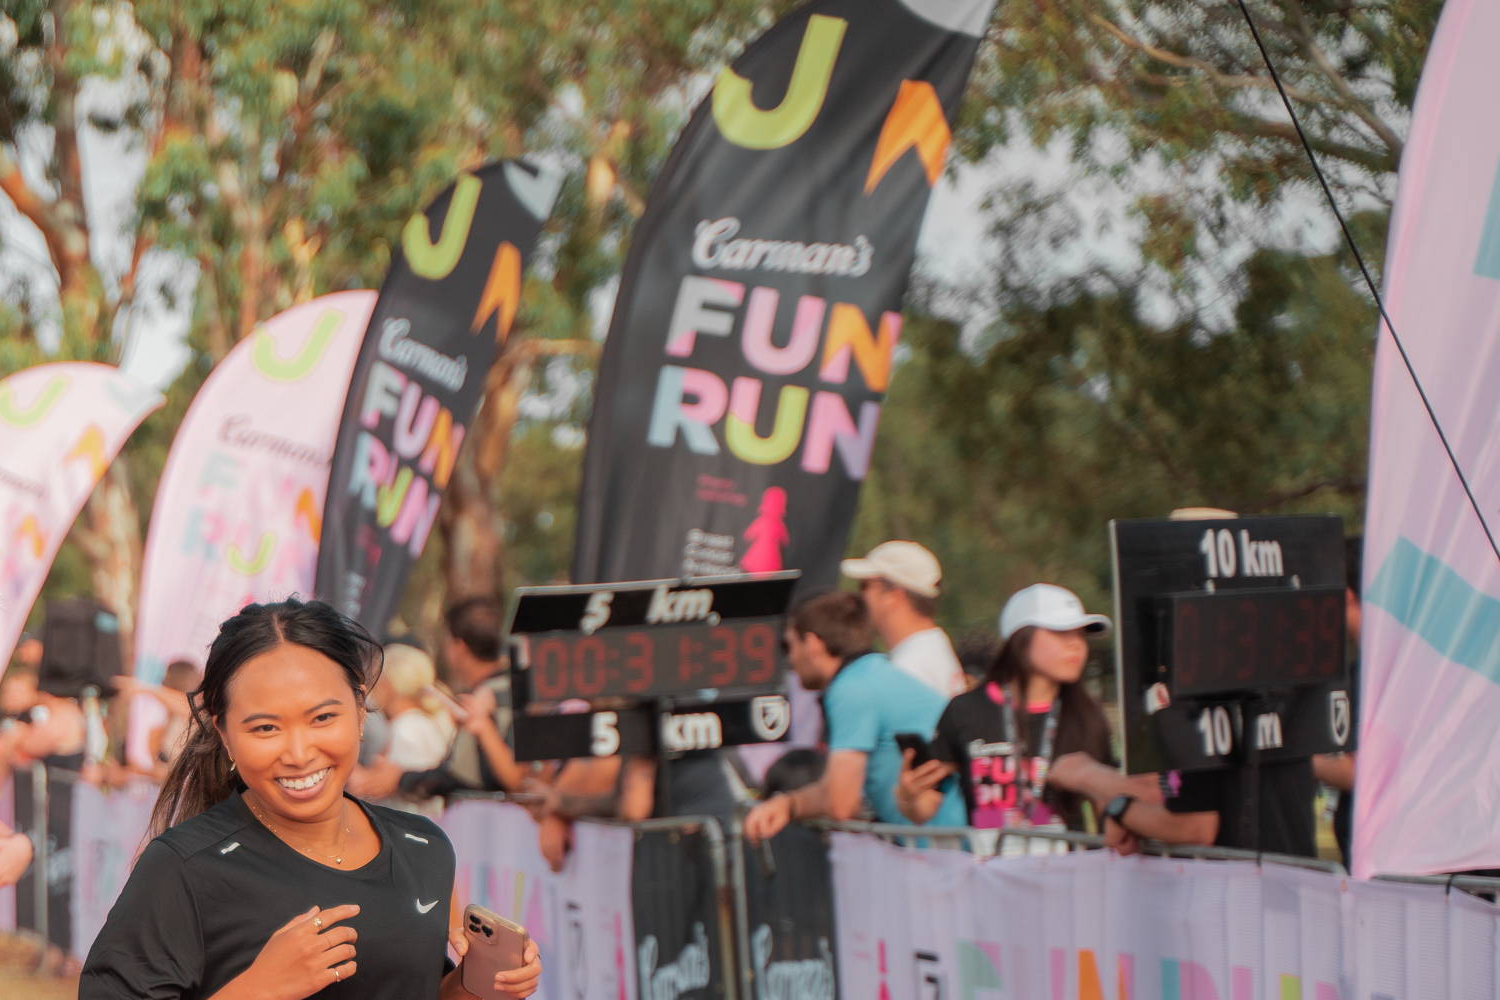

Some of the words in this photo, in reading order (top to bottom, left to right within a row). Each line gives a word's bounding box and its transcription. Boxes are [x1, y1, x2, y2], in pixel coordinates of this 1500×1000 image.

[692, 217, 874, 277] Carman's
[665, 274, 903, 392] FUN
[361, 360, 465, 489] FUN
[647, 364, 881, 480] RUN
[349, 431, 441, 558] RUN
[1200, 527, 1236, 578] 10
[1240, 528, 1284, 577] km
[581, 591, 614, 634] 5
[534, 623, 776, 699] 00:31:39
[591, 711, 620, 756] 5
[662, 712, 722, 752] km
[1200, 706, 1233, 757] 10
